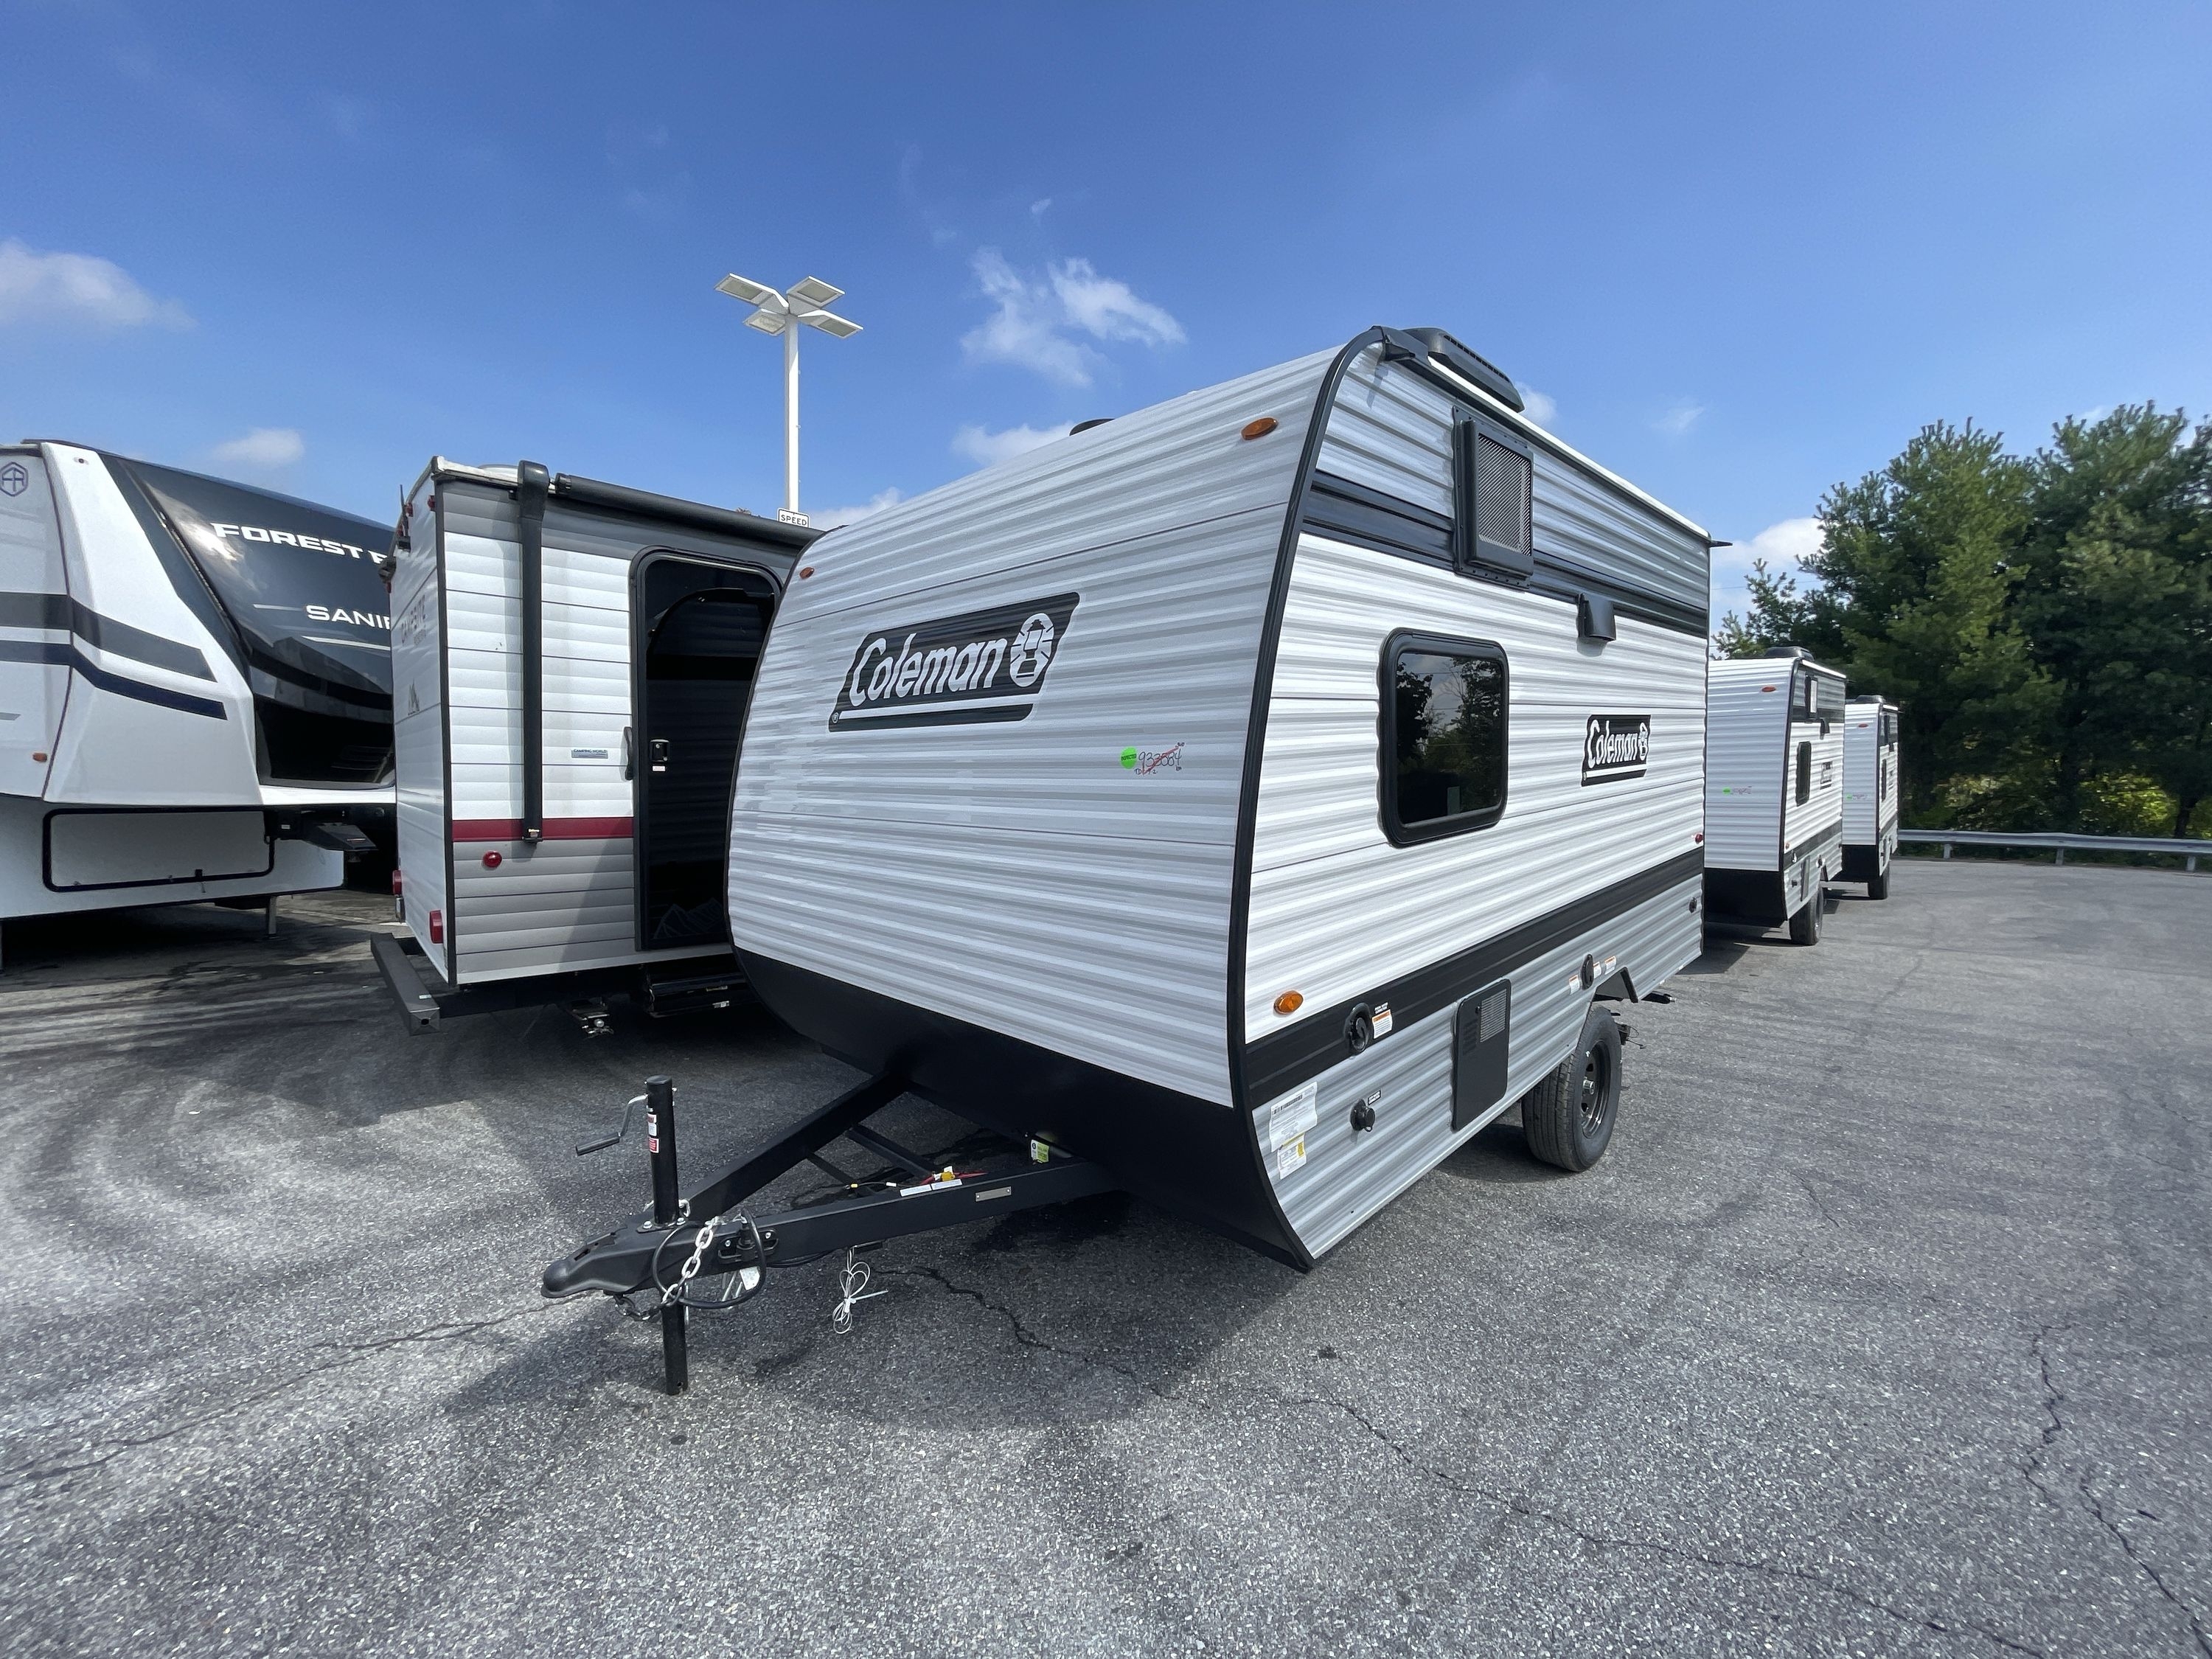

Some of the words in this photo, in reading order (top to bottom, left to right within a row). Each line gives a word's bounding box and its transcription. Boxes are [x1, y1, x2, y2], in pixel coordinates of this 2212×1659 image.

[209, 522, 364, 559] FOREST
[781, 514, 807, 526] SPEED
[849, 633, 1008, 706] Coleman
[1587, 720, 1638, 768] Coleman
